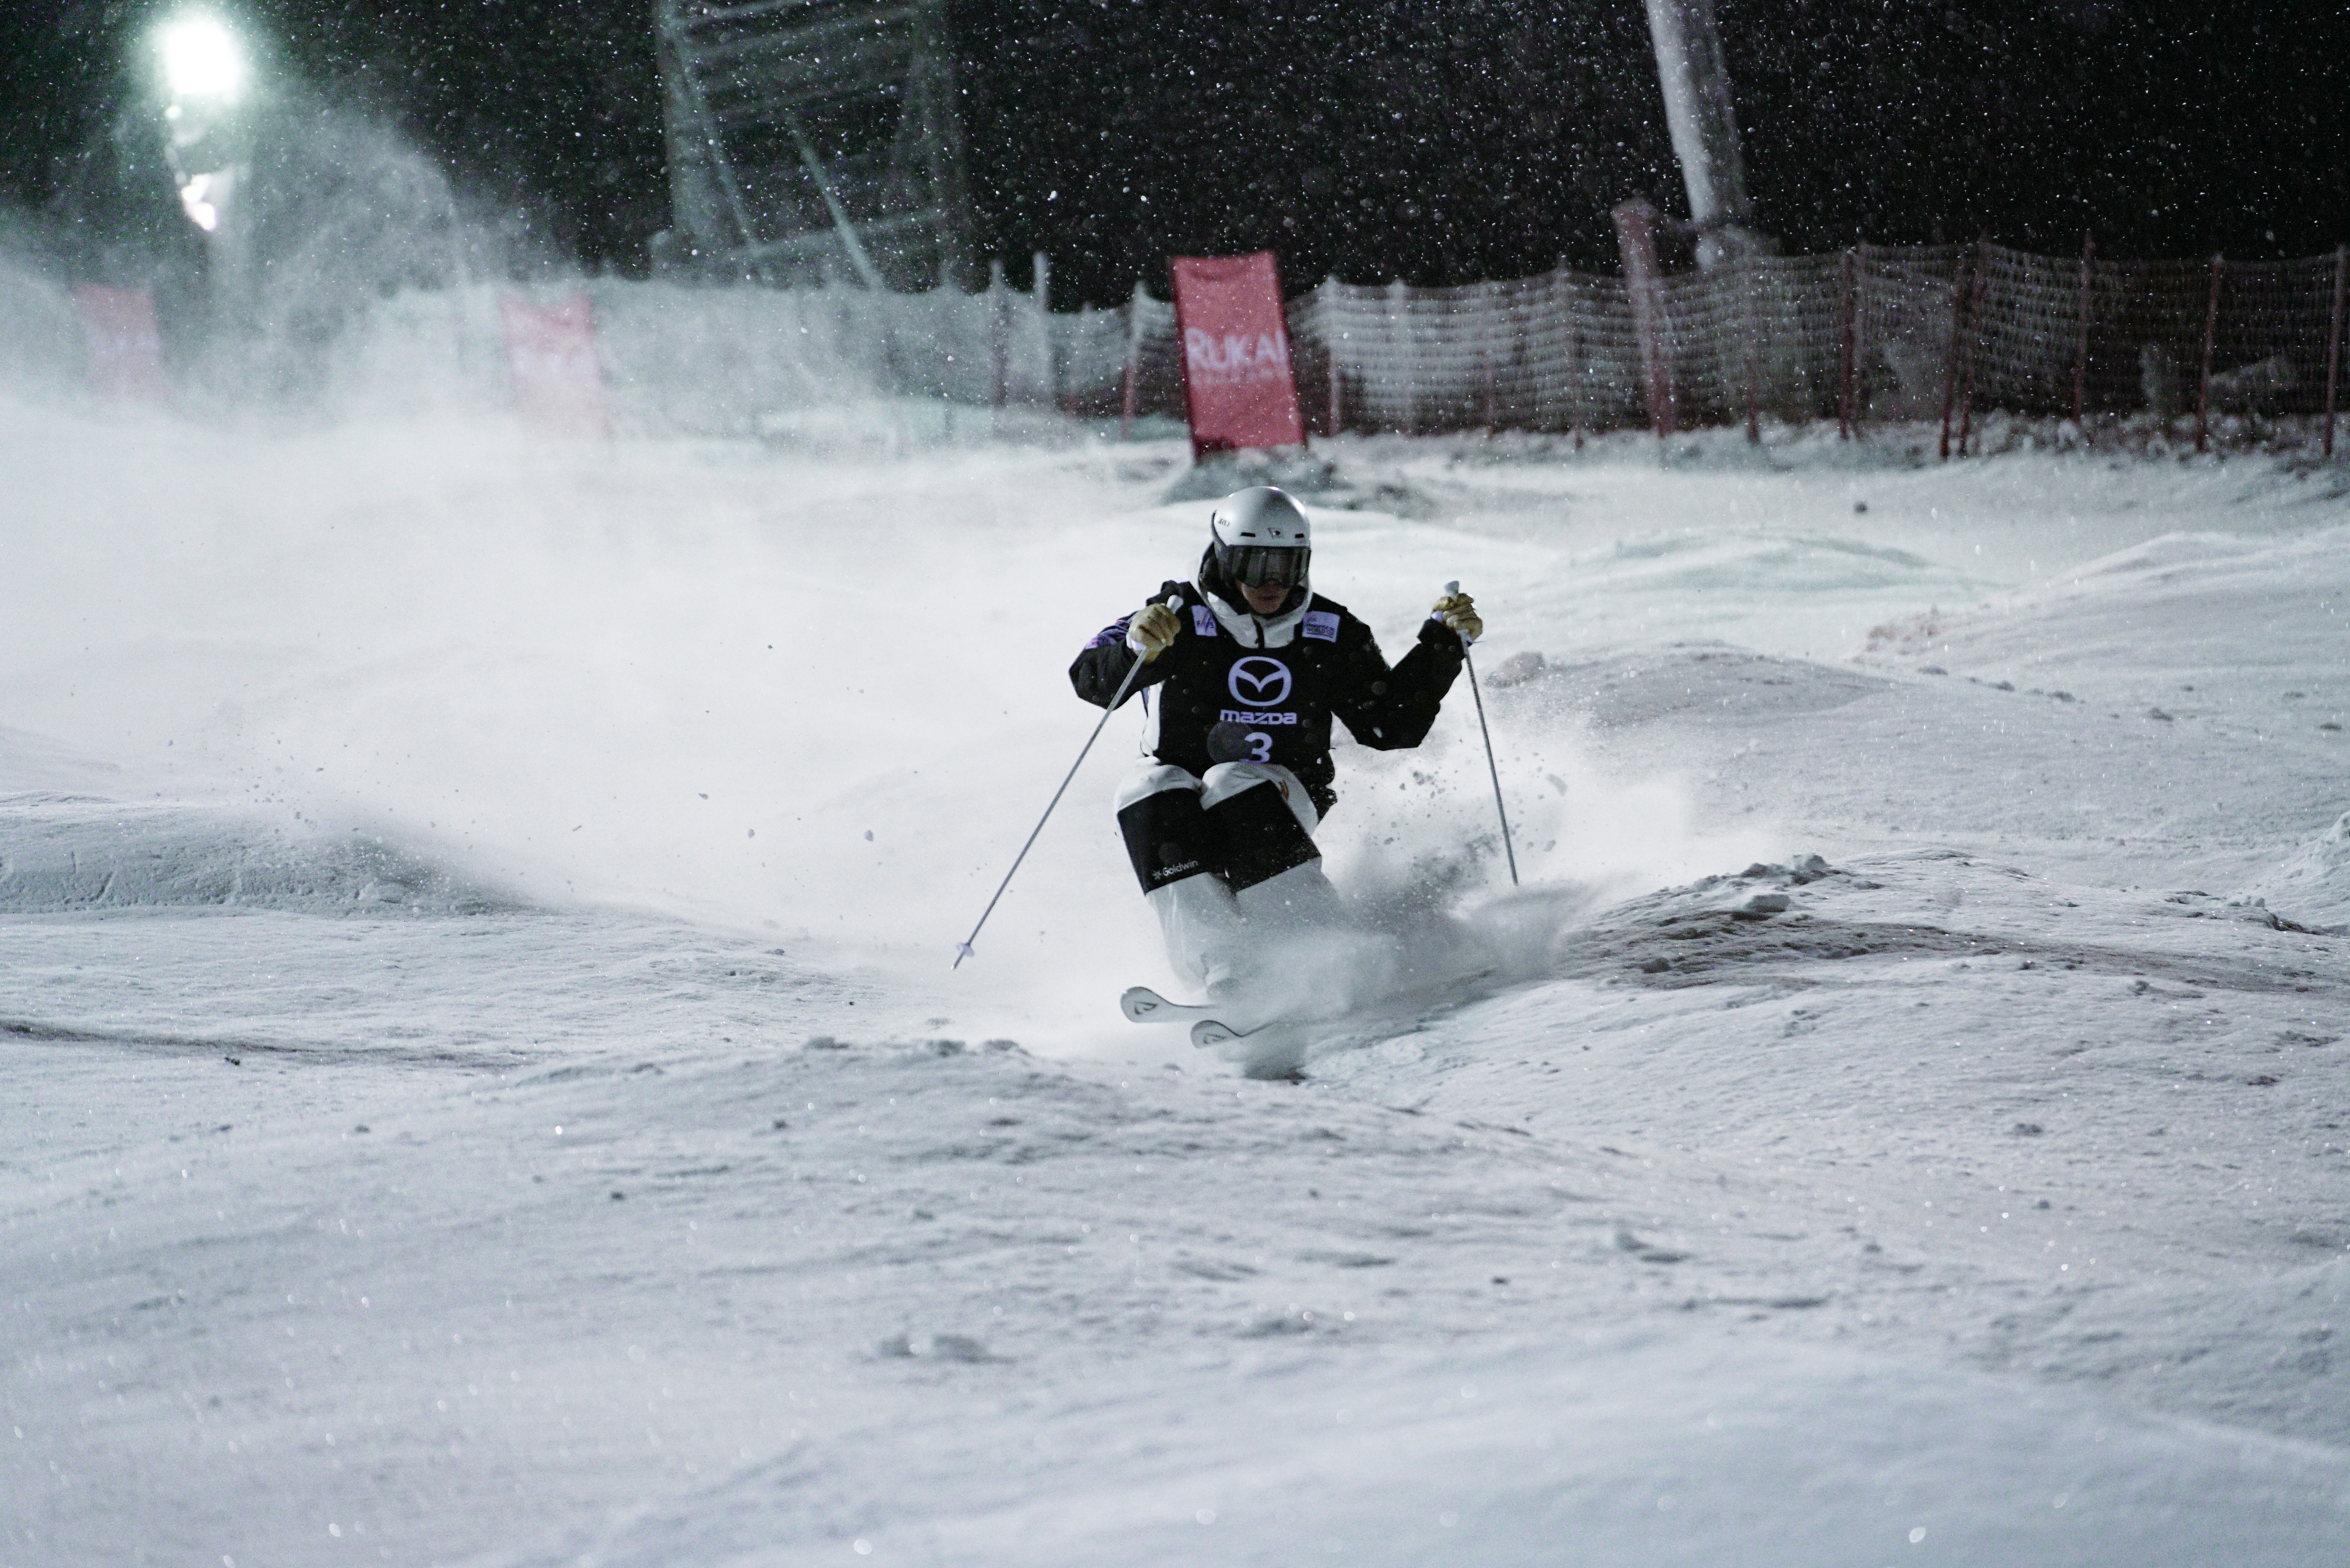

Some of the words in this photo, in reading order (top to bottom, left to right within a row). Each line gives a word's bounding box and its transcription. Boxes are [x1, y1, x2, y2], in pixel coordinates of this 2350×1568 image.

[1220, 709, 1297, 724] mazda
[1240, 732, 1272, 763] 3
[1163, 860, 1199, 877] Goldwin
